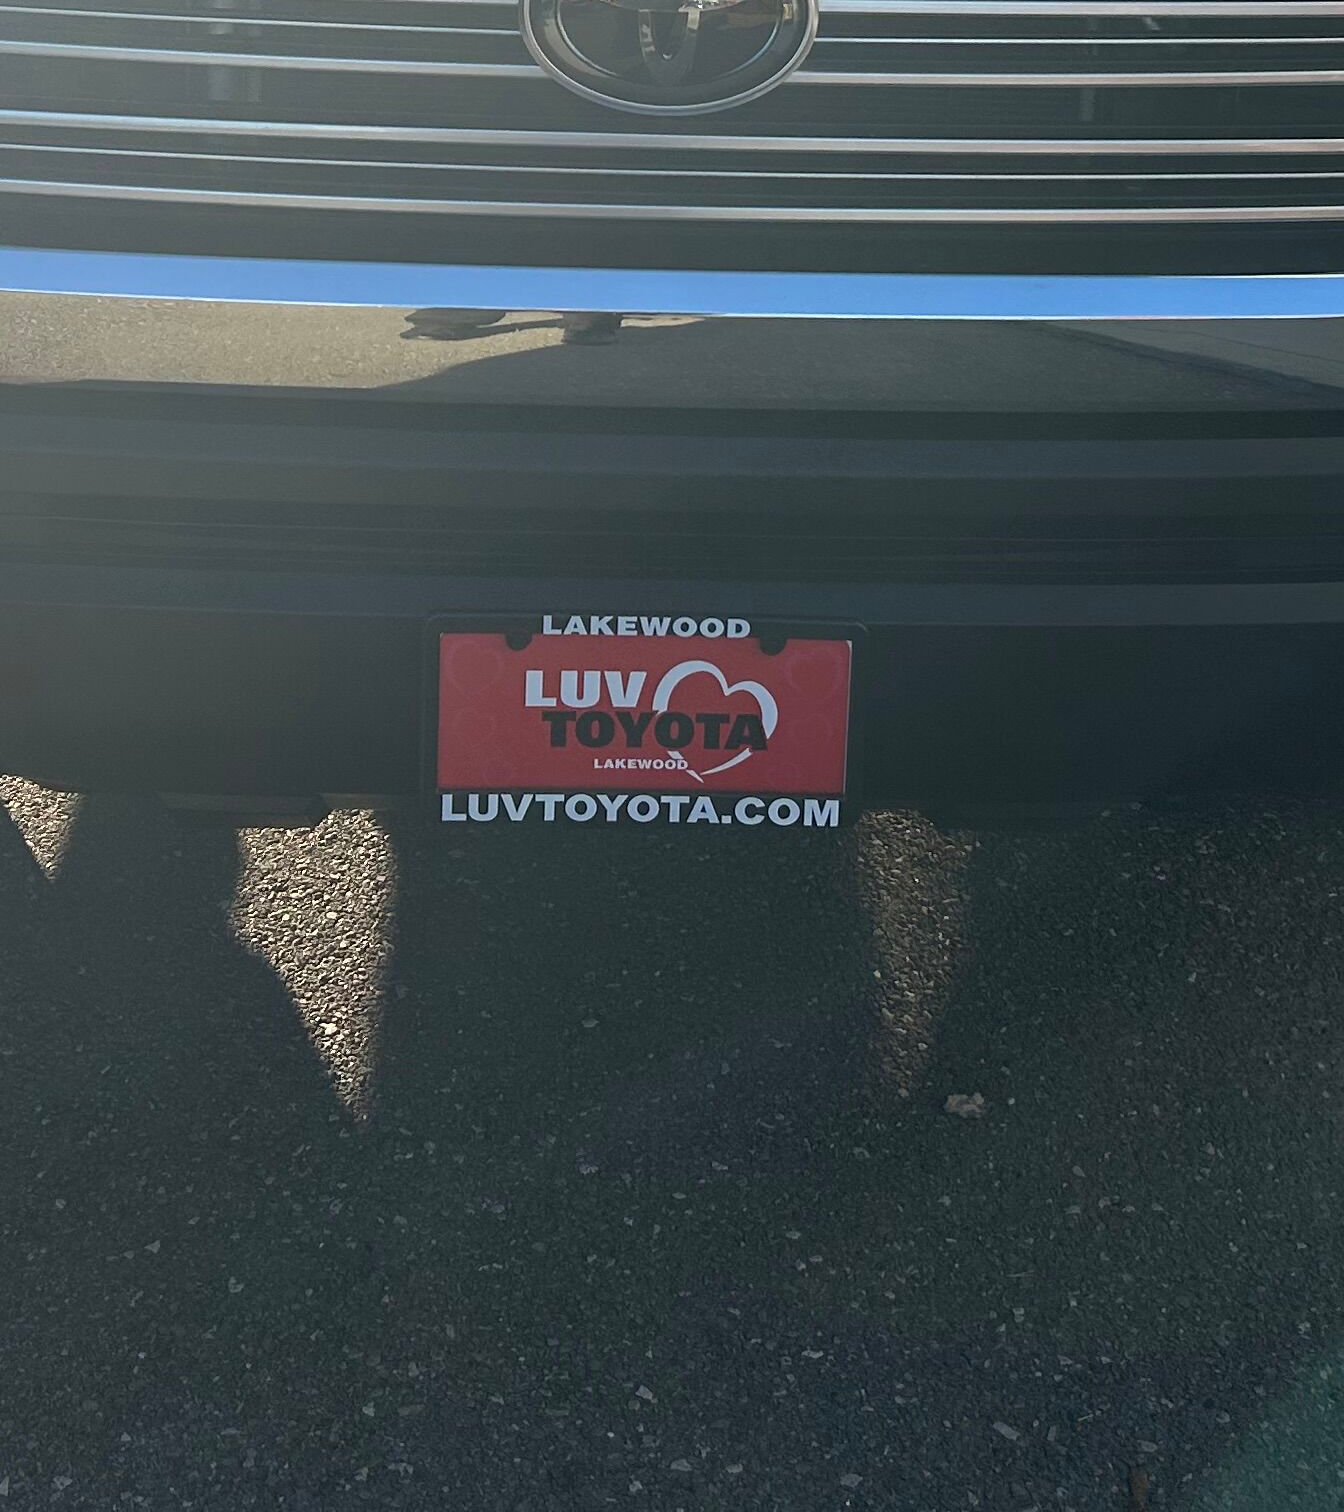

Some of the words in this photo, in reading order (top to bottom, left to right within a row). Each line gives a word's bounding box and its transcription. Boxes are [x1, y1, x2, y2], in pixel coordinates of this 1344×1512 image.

[541, 614, 752, 639] LAKEWOOD
[524, 669, 648, 708] LUV
[541, 709, 768, 751] TOYOTA
[593, 757, 689, 771] LAKEWOOD
[441, 793, 841, 828] LUVTOYOTA.COM
